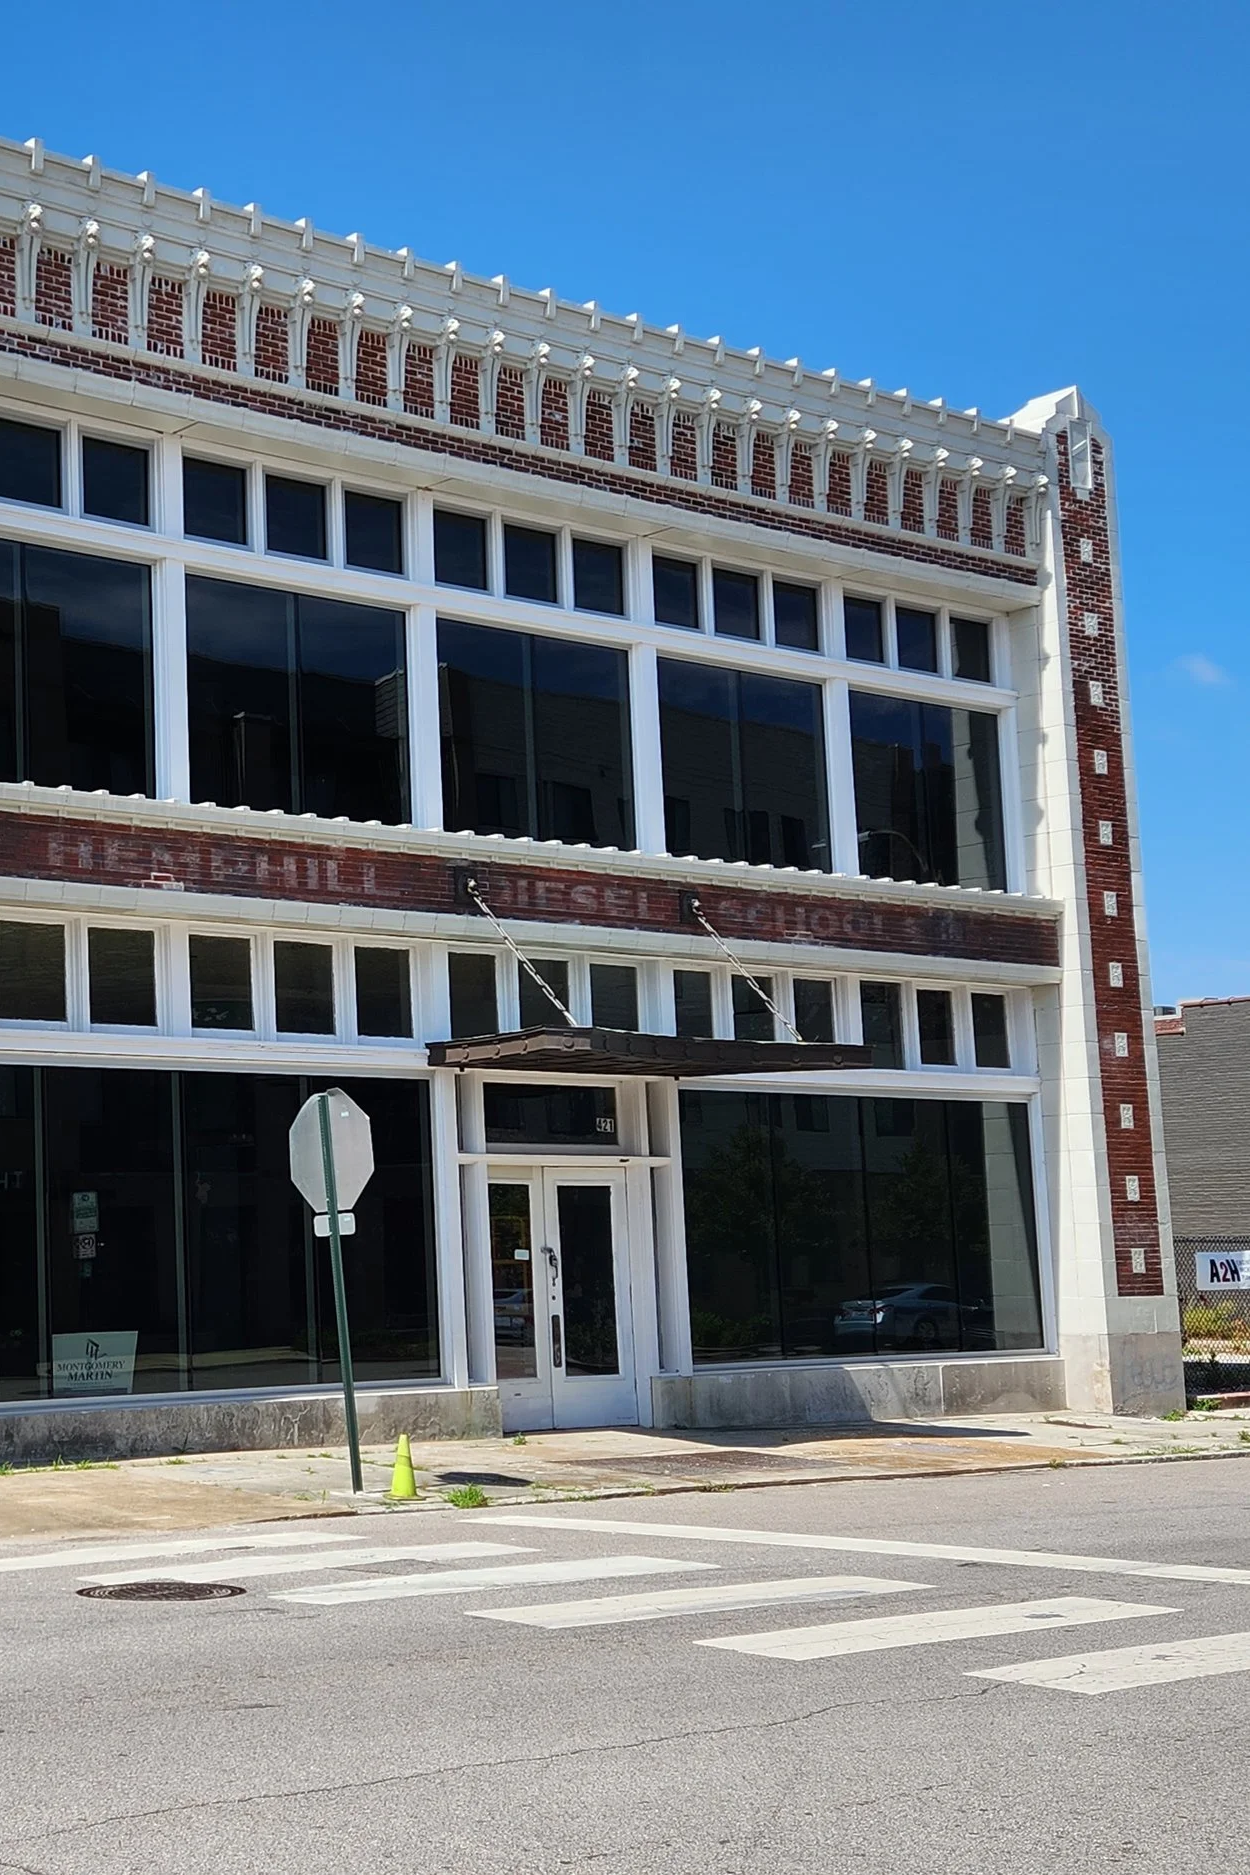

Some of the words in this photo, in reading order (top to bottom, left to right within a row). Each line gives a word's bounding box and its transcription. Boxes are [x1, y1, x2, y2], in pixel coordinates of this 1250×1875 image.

[49, 831, 405, 897] HEMPHILL
[596, 1118, 613, 1132] 421
[1209, 1259, 1241, 1283] A2H
[57, 1360, 126, 1372] MONTGOMERY
[66, 1370, 113, 1381] MARTIN
